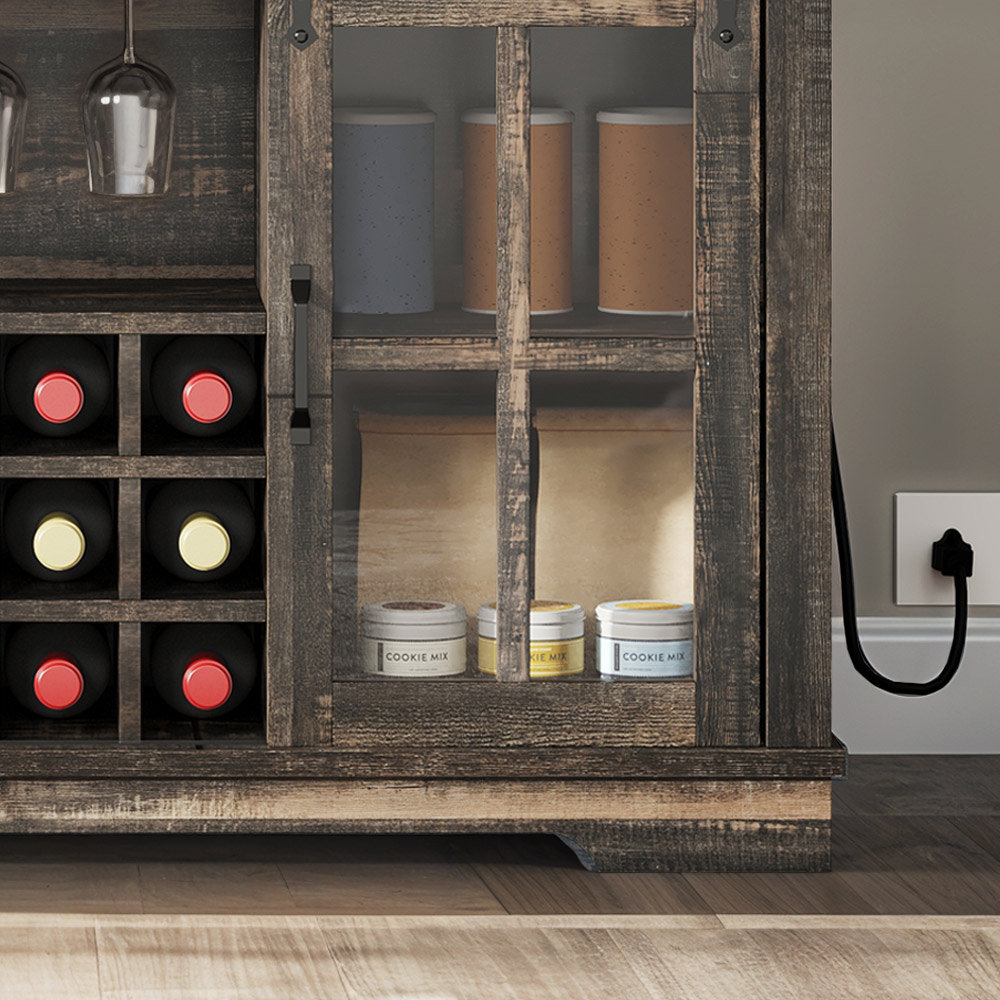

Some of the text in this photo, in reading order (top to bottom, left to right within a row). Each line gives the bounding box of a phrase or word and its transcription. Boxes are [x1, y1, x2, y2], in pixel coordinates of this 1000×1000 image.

[385, 651, 448, 662] COOKIE MIX
[530, 652, 567, 662] KIE MIX
[623, 651, 685, 662] COOKIE MIX
